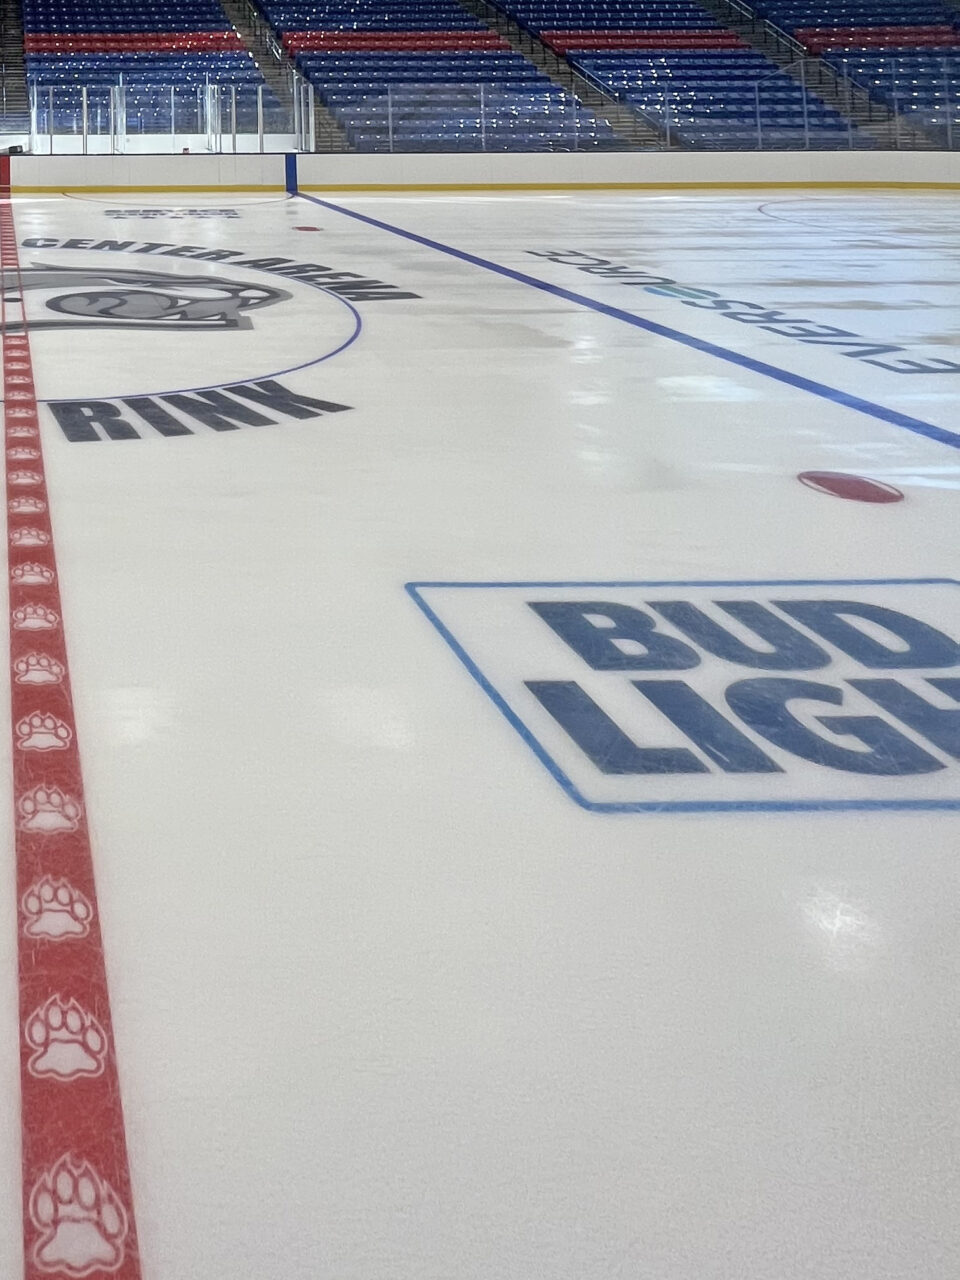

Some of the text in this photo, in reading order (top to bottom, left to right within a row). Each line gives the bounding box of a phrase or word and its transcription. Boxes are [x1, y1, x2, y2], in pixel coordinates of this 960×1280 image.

[21, 238, 245, 261] CENTER
[229, 257, 423, 301] ARENA
[47, 379, 356, 442] RINK
[526, 600, 960, 670] BUD
